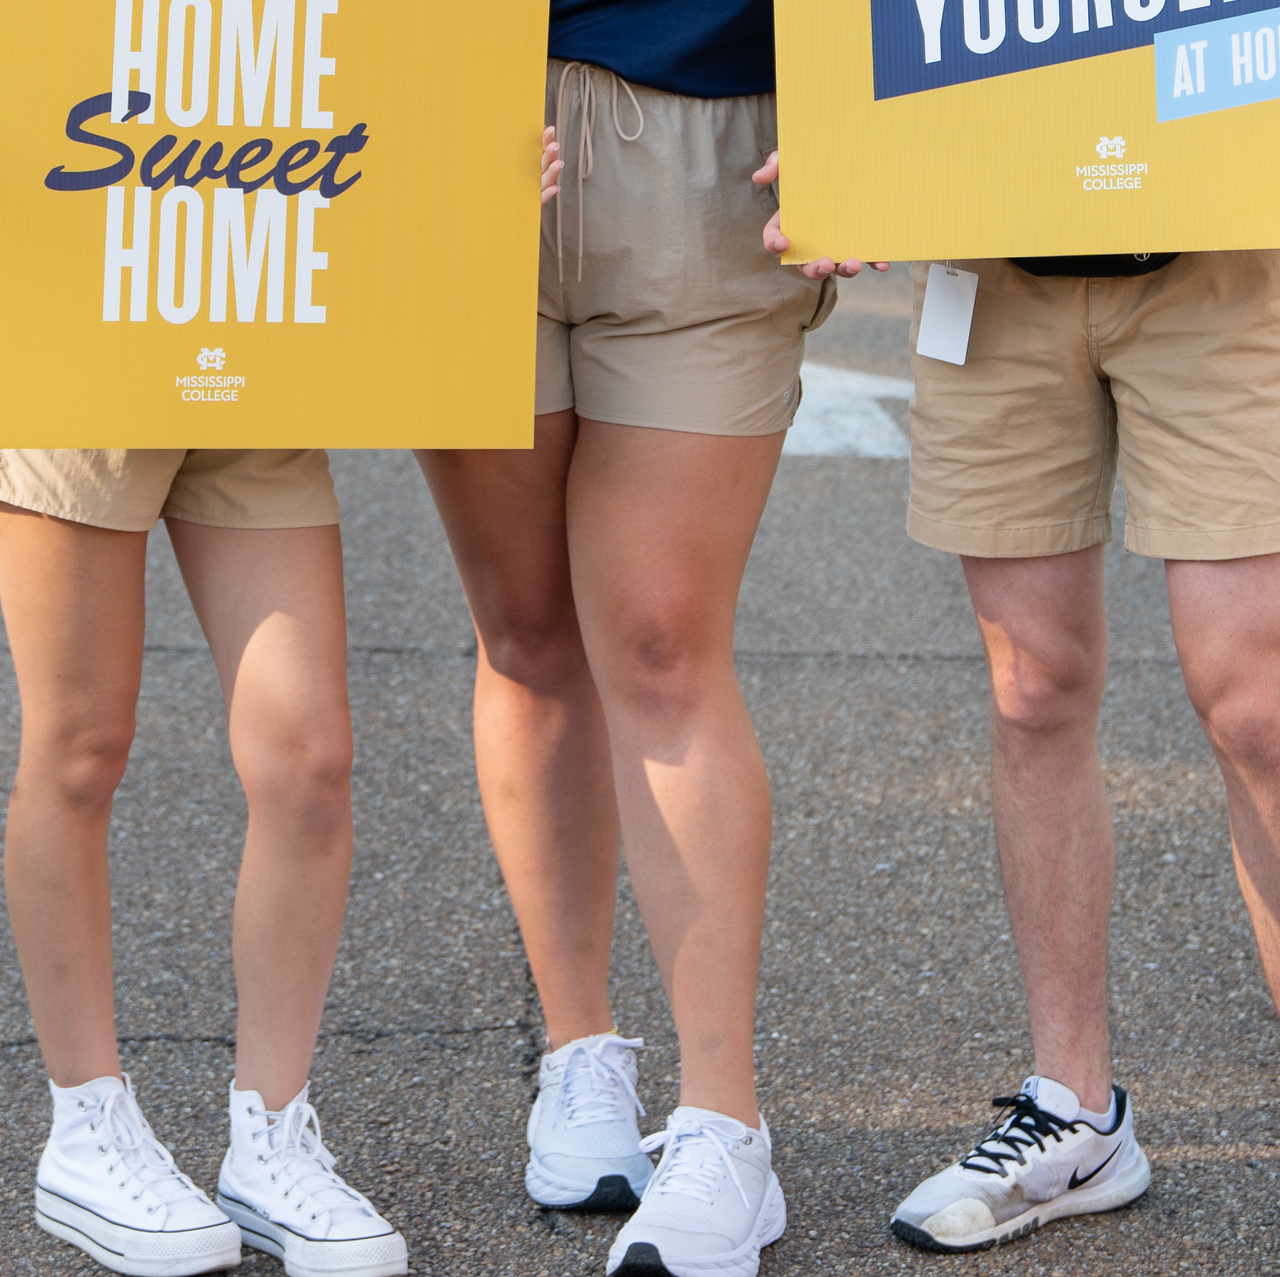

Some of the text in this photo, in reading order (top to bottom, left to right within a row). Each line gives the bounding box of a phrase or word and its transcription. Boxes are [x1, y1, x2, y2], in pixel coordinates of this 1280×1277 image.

[1173, 41, 1208, 99] AT
[44, 91, 369, 198] Sweet
[1076, 163, 1148, 177] MISSISSIPPI
[1083, 177, 1142, 191] COLLEGE
[102, 185, 330, 324] HOME
[176, 376, 245, 388] MISSISSIPPI
[181, 389, 238, 402] COLLEGE
